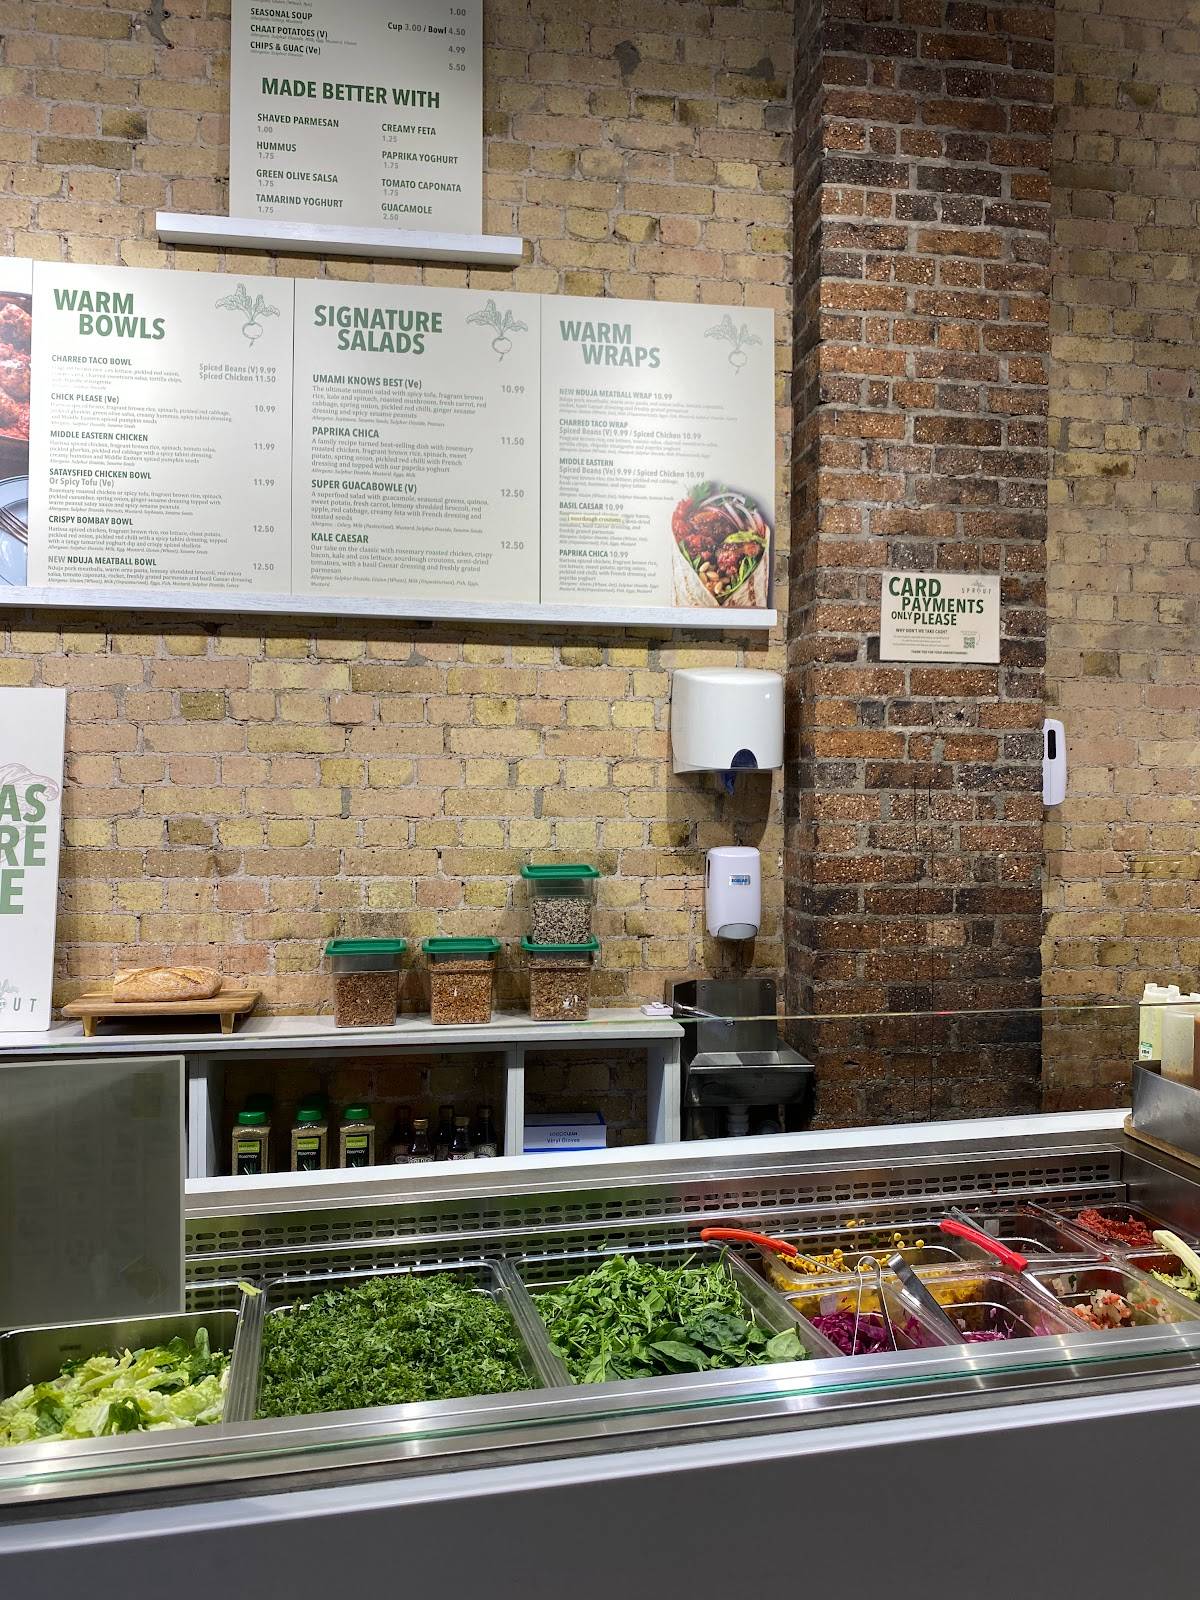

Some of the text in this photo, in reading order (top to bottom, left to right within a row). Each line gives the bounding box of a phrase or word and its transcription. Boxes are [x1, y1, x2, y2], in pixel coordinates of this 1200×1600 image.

[251, 8, 312, 20] SEASONAL SOUP
[449, 8, 466, 16] 1.00
[251, 25, 276, 33] CHAAT
[278, 27, 315, 37] POTATOES
[317, 30, 328, 39] (V)
[388, 22, 402, 32] Cup
[428, 26, 447, 34] Bowl
[448, 28, 465, 36] 4.50
[251, 41, 273, 50] CHIPS
[306, 46, 320, 55] (Ve)
[448, 46, 465, 54] 4.99
[448, 63, 465, 71] 5.50
[262, 77, 440, 108] MADE BETTER WITH
[257, 113, 339, 127] SHAVED PARMESAN
[382, 124, 436, 135] CREAMY FETA
[257, 141, 296, 152] HUMMUS
[382, 151, 458, 164] PAPRIKA YOGHURT
[256, 169, 338, 183] GREEN OLIVE SALSA
[381, 179, 461, 192] TOMATO CAPONATA
[256, 194, 343, 207] TAMARIND YOGHURT
[259, 206, 274, 214] 1.75
[381, 203, 432, 214] GUACAMOLE
[383, 213, 399, 221] 2.50
[54, 289, 134, 315] WARM
[314, 304, 443, 333] SIGNATURE
[79, 314, 165, 340] BOWLS
[560, 320, 631, 344] WARM
[338, 329, 425, 355] SALADS
[52, 355, 87, 364] CHARRED
[110, 358, 132, 366] BOWL
[582, 344, 660, 368] WRAPS
[200, 363, 223, 373] Spiced
[225, 365, 246, 373] Beans
[248, 366, 258, 374] (V)
[200, 373, 223, 382] Spiced
[225, 374, 253, 382] Chicken
[313, 374, 422, 389] UMAMI KNOWS BEST (Ve)
[502, 385, 524, 393] 10.99
[599, 390, 631, 398] MEATBALL
[51, 393, 119, 404] CHICK PLEASE (Ve)
[255, 405, 275, 413] 10.99
[559, 419, 589, 427] CHARRED
[50, 430, 79, 439] MIDDLE
[82, 432, 113, 440] EASTERN
[312, 427, 379, 438] PAPRIKA CHICA
[559, 427, 580, 435] Spiced
[603, 429, 612, 437] (V)
[634, 430, 654, 439] Spiced
[656, 431, 681, 439] Chicken
[501, 437, 524, 445] 11.50
[586, 459, 613, 467] EASTERN
[50, 468, 151, 479] SATAYSFIED CHICKEN BOWL
[603, 468, 616, 476] (Ve)
[637, 469, 658, 478] Spiced
[50, 478, 114, 488] Or Spicy Tofu (Ve)
[312, 480, 417, 493] SUPER GUACABOWLE (V)
[501, 489, 524, 497] 12.50
[49, 516, 75, 524] CRISPY
[77, 517, 109, 525] BOMBAY
[253, 525, 274, 533] 12.50
[311, 533, 368, 543] KALE CAESAR
[501, 541, 524, 549] 12.50
[559, 549, 587, 557] PAPRIKA
[67, 556, 93, 564] NDUJA
[95, 557, 133, 565] MEATBALL
[889, 577, 941, 597] CARD
[902, 597, 984, 614] PAYMENTS
[891, 611, 956, 625] ONLY PLEASE
